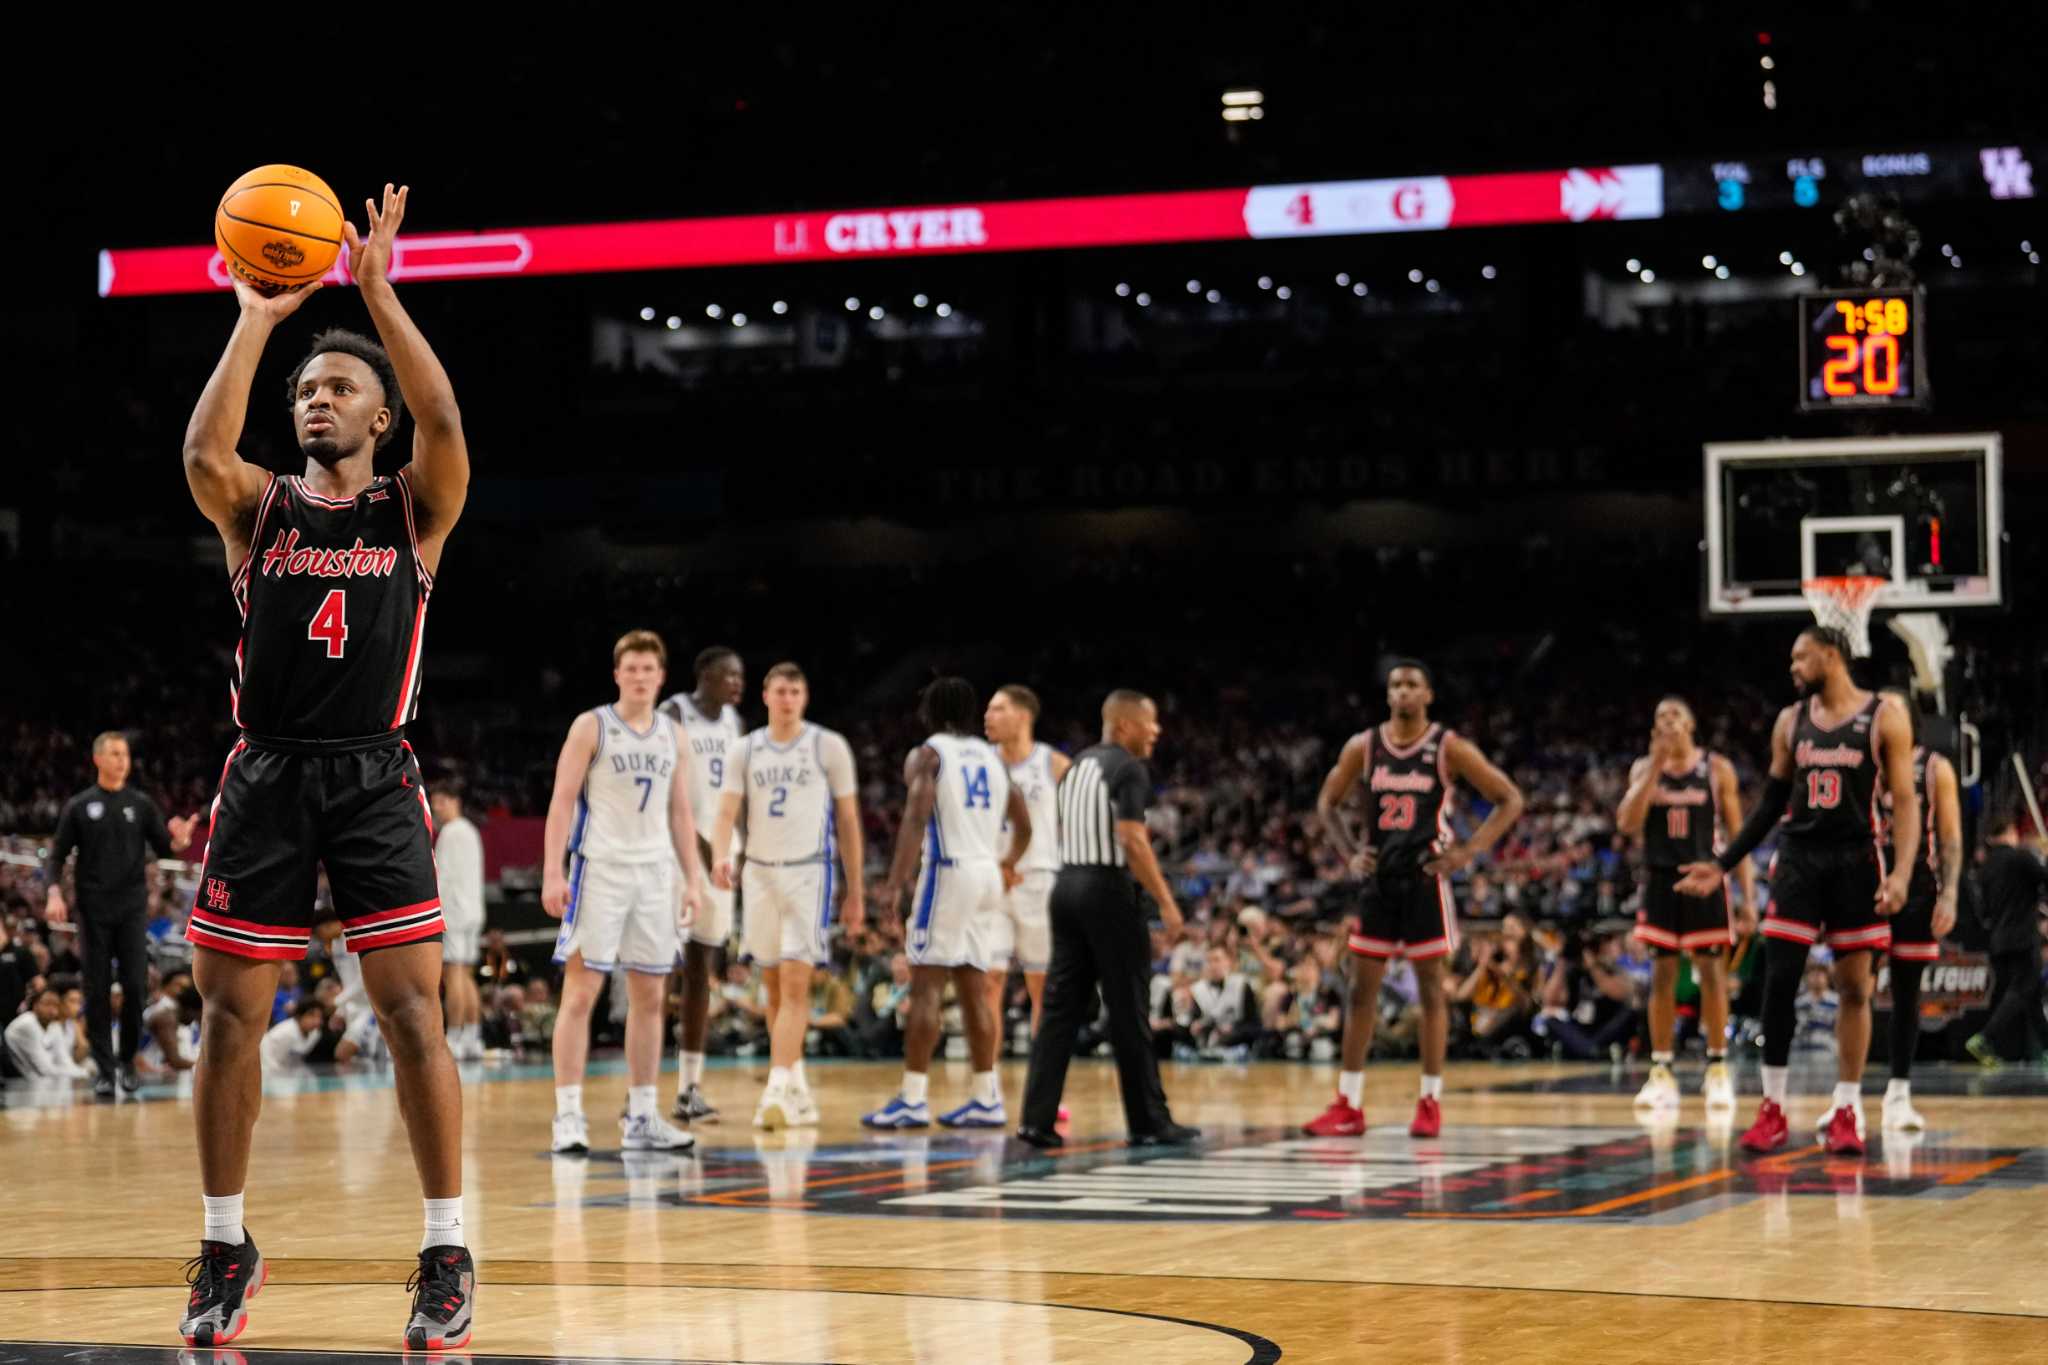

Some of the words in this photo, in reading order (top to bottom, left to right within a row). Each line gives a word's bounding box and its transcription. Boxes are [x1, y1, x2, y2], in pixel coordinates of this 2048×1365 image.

[1860, 152, 1930, 177] BONUS
[1286, 195, 1314, 225] 4
[1394, 185, 1425, 221] G
[824, 207, 989, 254] CRYER
[1835, 298, 1907, 335] 7:58
[1824, 335, 1899, 396] 20
[261, 528, 398, 579] Houston
[308, 589, 348, 658] 4
[611, 752, 672, 778] DUKE
[709, 757, 724, 789] 9
[753, 765, 811, 788] DUKE
[634, 776, 652, 813] 7
[767, 786, 788, 818] 2
[961, 765, 990, 809] 14
[1806, 768, 1843, 811] 13
[1377, 793, 1416, 832] 23
[1666, 806, 1691, 840] 11
